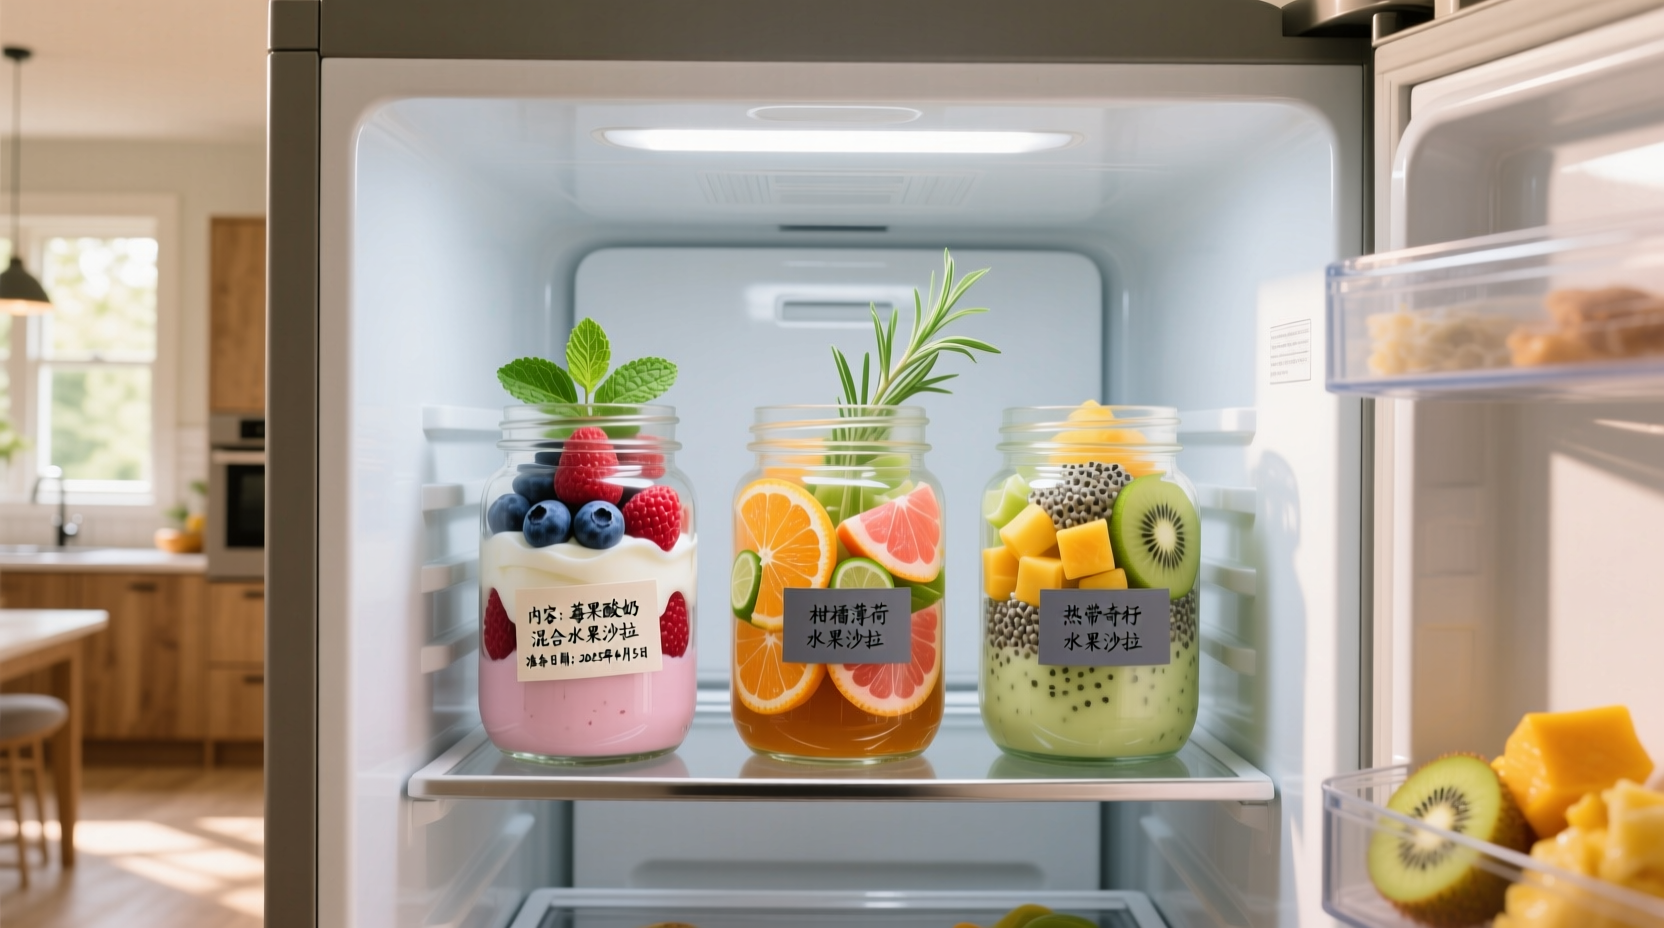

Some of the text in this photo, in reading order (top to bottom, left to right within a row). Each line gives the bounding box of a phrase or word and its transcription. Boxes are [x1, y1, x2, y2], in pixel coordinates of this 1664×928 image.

[531, 622, 639, 648] 混合水果沙拉
[806, 628, 884, 650] 水果沙拉
[1065, 631, 1143, 653] 水果沙拉
